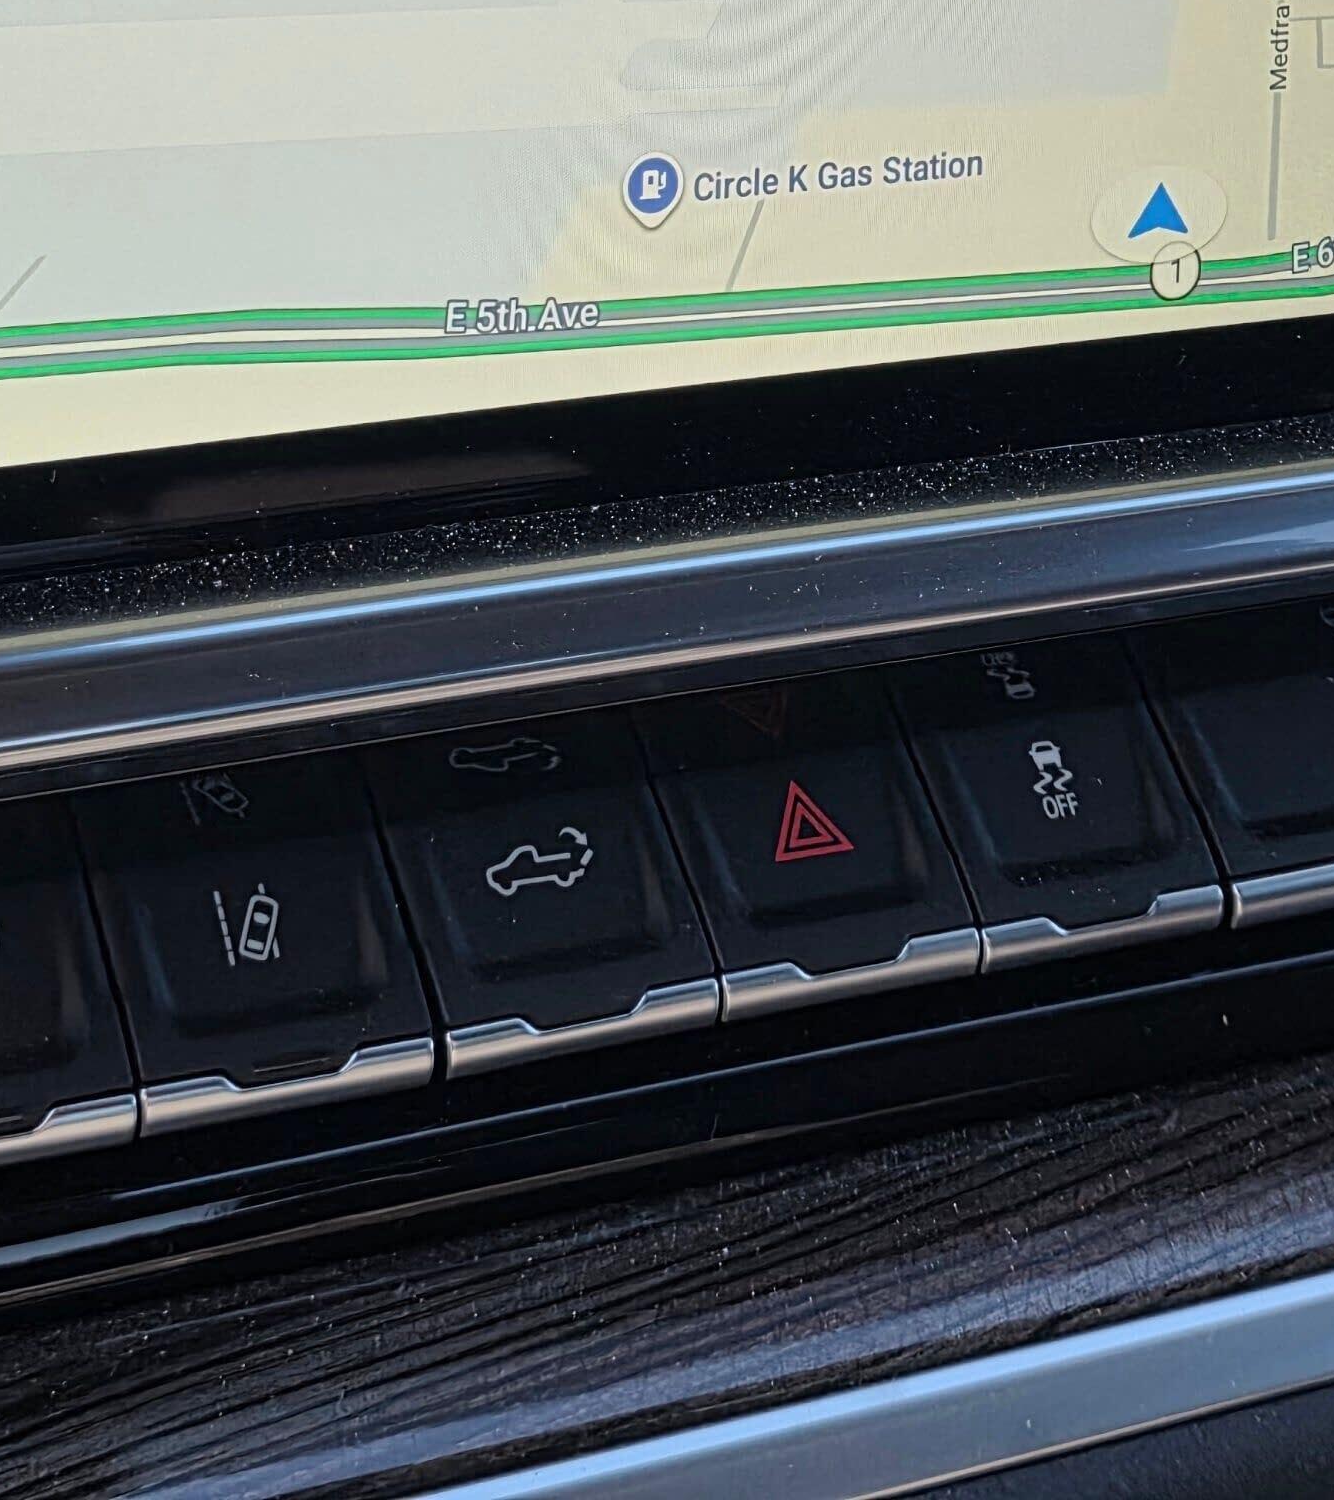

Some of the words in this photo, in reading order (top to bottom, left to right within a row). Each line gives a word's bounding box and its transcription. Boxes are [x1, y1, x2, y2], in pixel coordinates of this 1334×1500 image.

[1269, 13, 1291, 91] Medfra
[693, 163, 780, 203] Circle
[787, 163, 807, 194] K
[817, 157, 872, 192] Gas
[882, 148, 983, 186] Station
[1291, 244, 1311, 274] E
[445, 301, 470, 334] E
[474, 299, 527, 334] 5th
[534, 298, 600, 330] Ave
[1042, 792, 1078, 819] OFF
